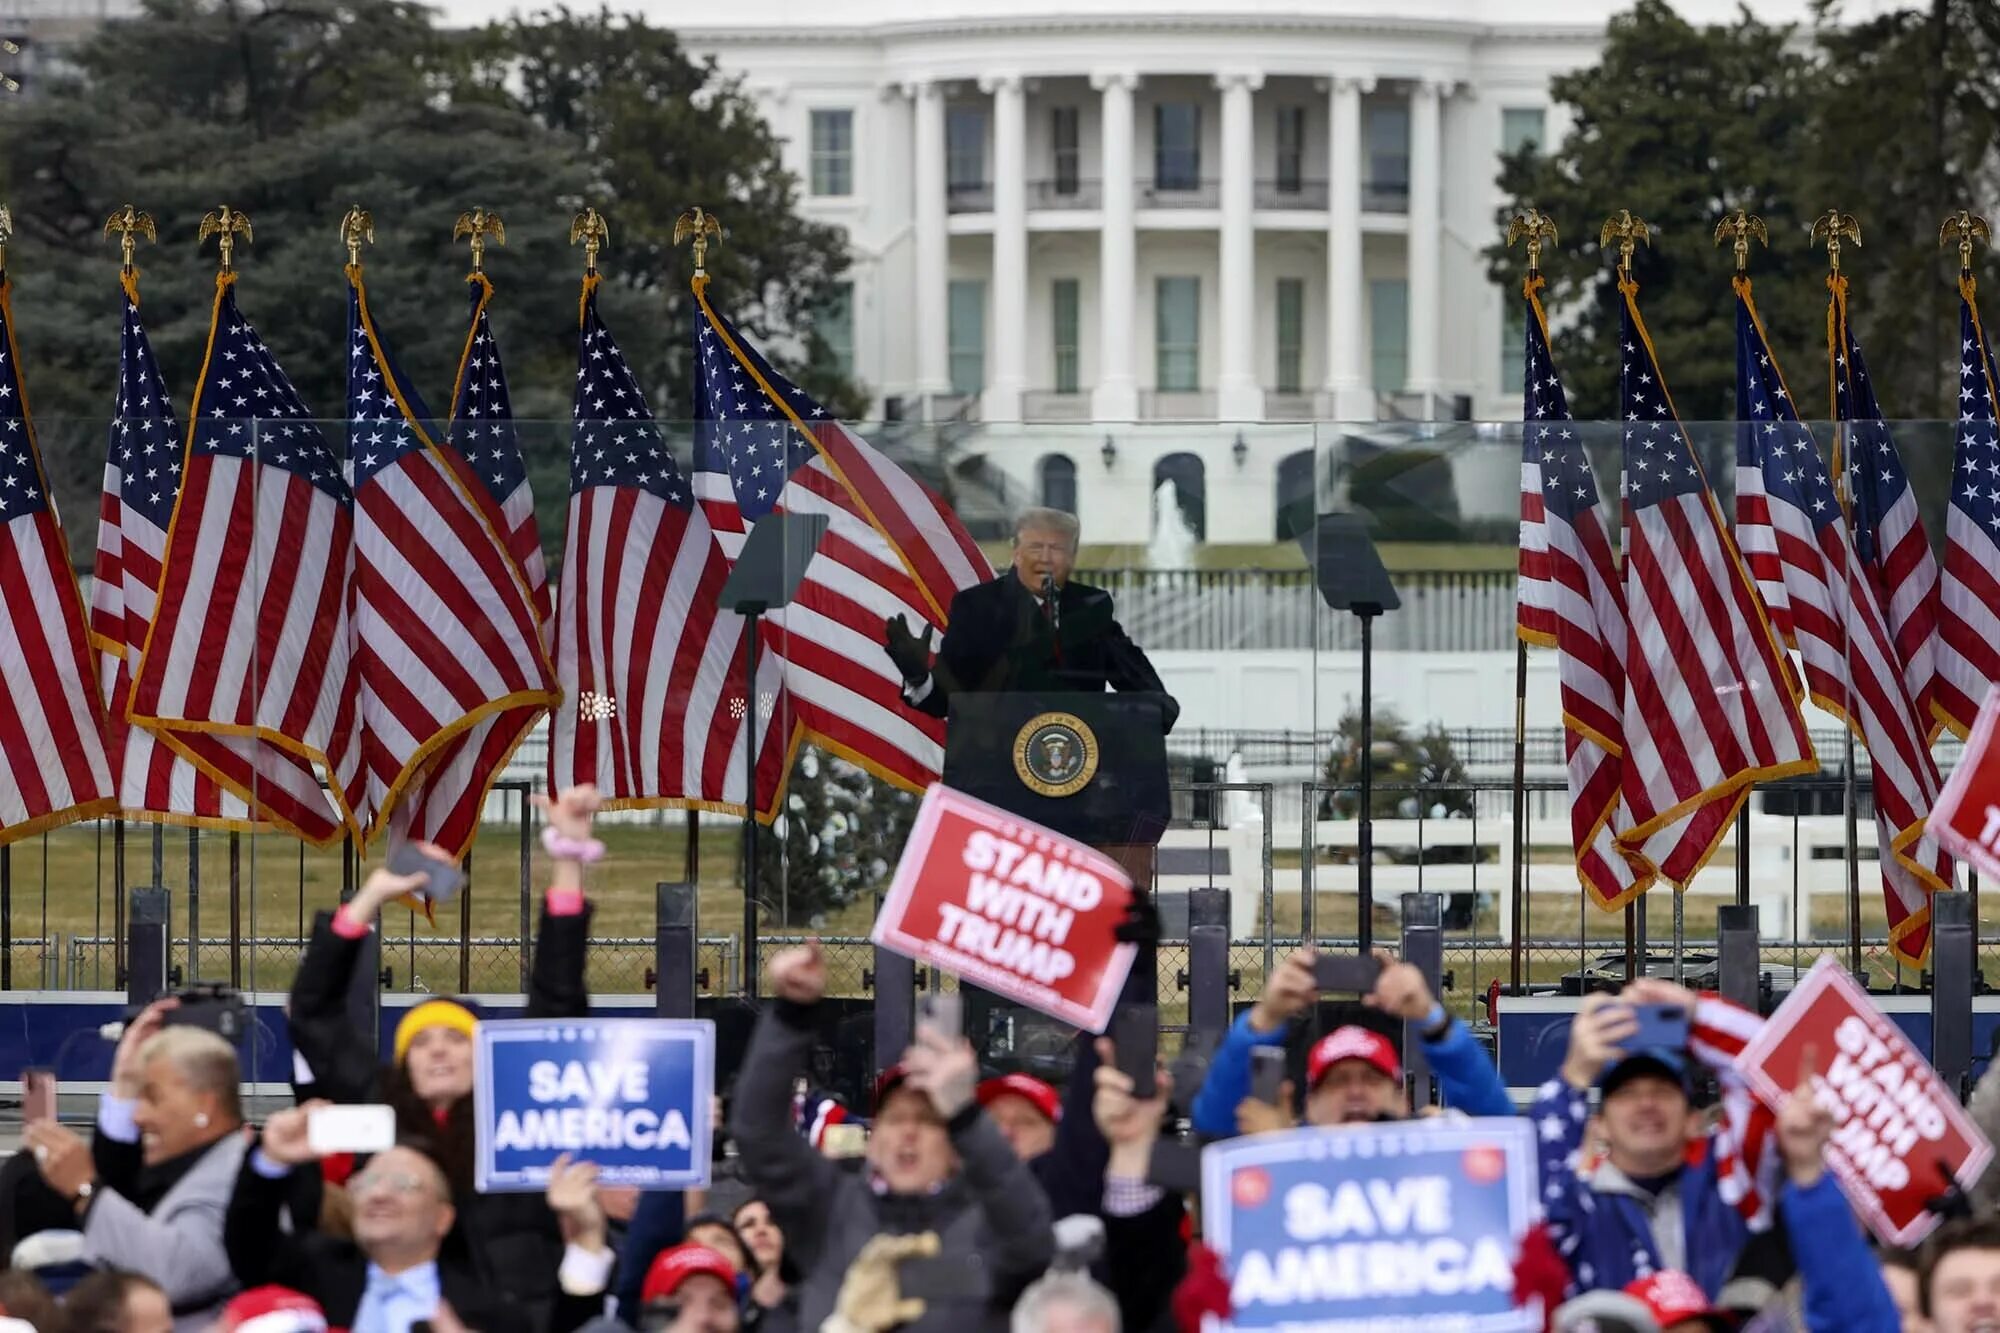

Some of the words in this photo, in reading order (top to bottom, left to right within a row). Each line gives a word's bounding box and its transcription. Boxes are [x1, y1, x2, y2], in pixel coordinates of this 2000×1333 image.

[962, 830, 1102, 911] STAND
[937, 902, 1075, 984] TRUMP
[967, 871, 1075, 945] WITH
[529, 1060, 650, 1102] SAVE
[1826, 1051, 1918, 1157] WITH
[1834, 1015, 1947, 1141] STAND
[495, 1108, 691, 1151] AMERICA
[1284, 1175, 1451, 1241] SAVE
[1230, 1237, 1513, 1306] AMERICA
